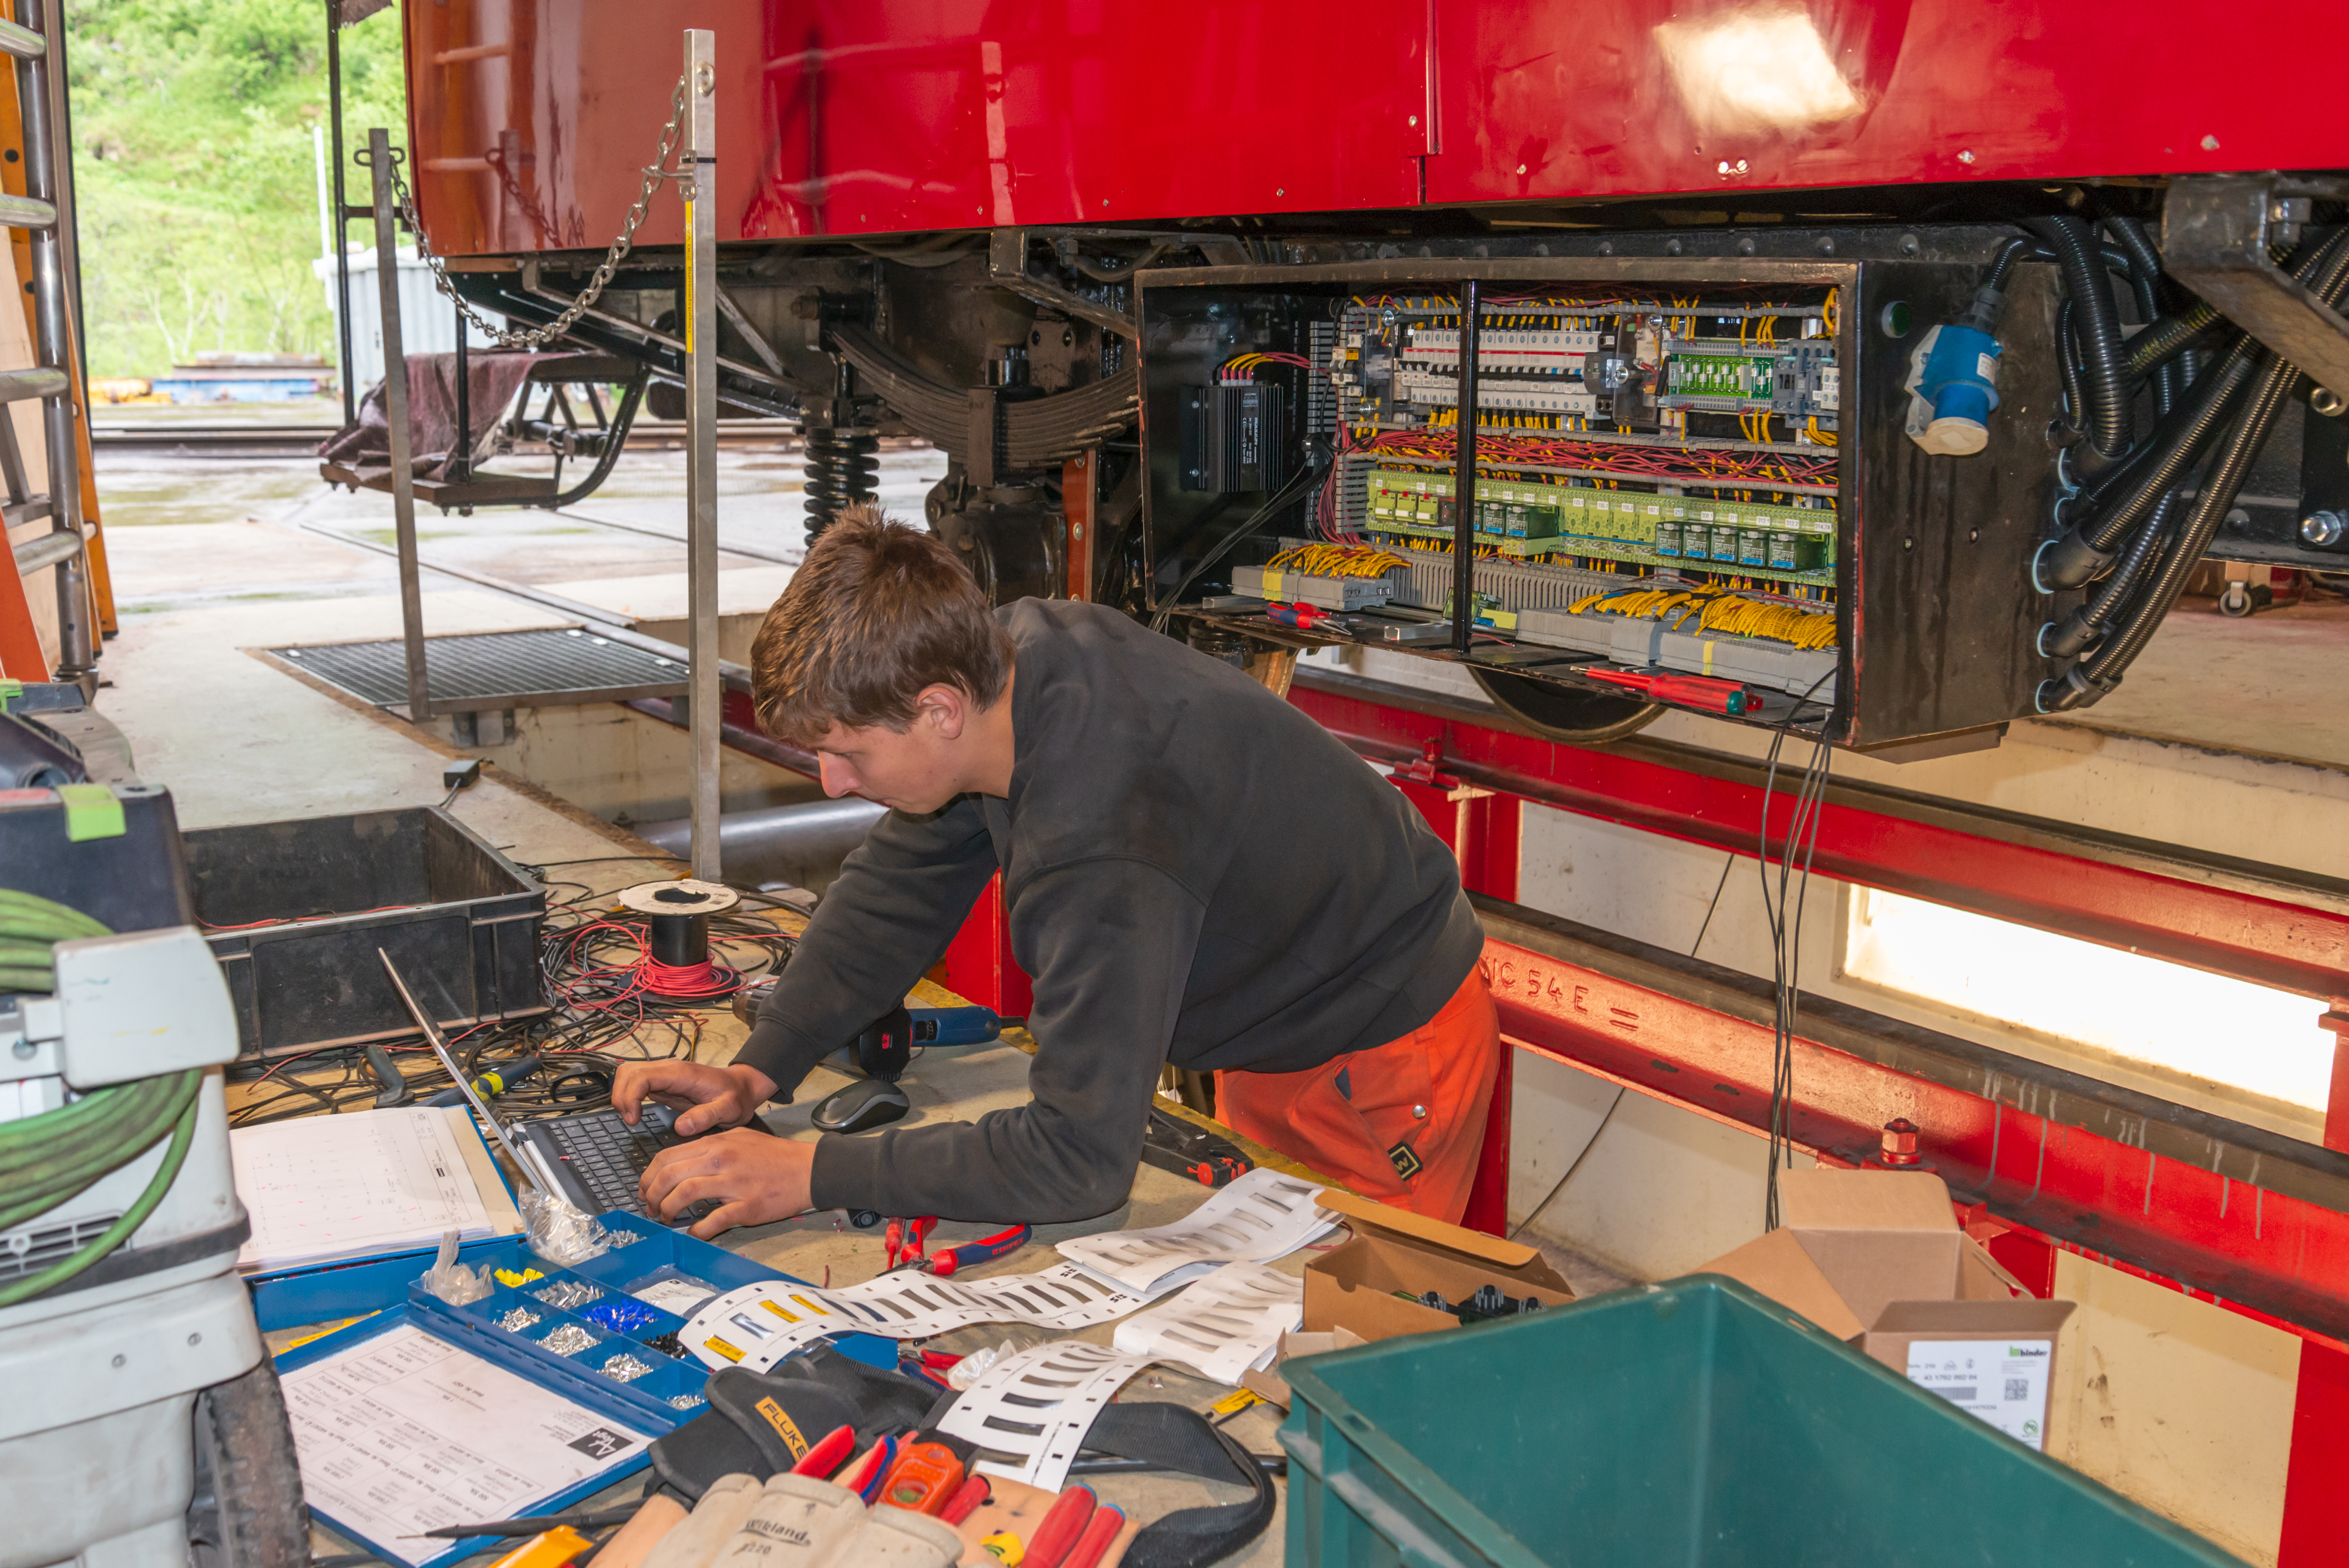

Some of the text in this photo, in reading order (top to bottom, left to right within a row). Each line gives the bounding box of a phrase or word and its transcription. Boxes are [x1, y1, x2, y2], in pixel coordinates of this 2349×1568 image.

[992, 1236, 1024, 1256] KNIPEX
[2020, 1346, 2048, 1358] binder
[763, 1402, 807, 1459] FLUKE
